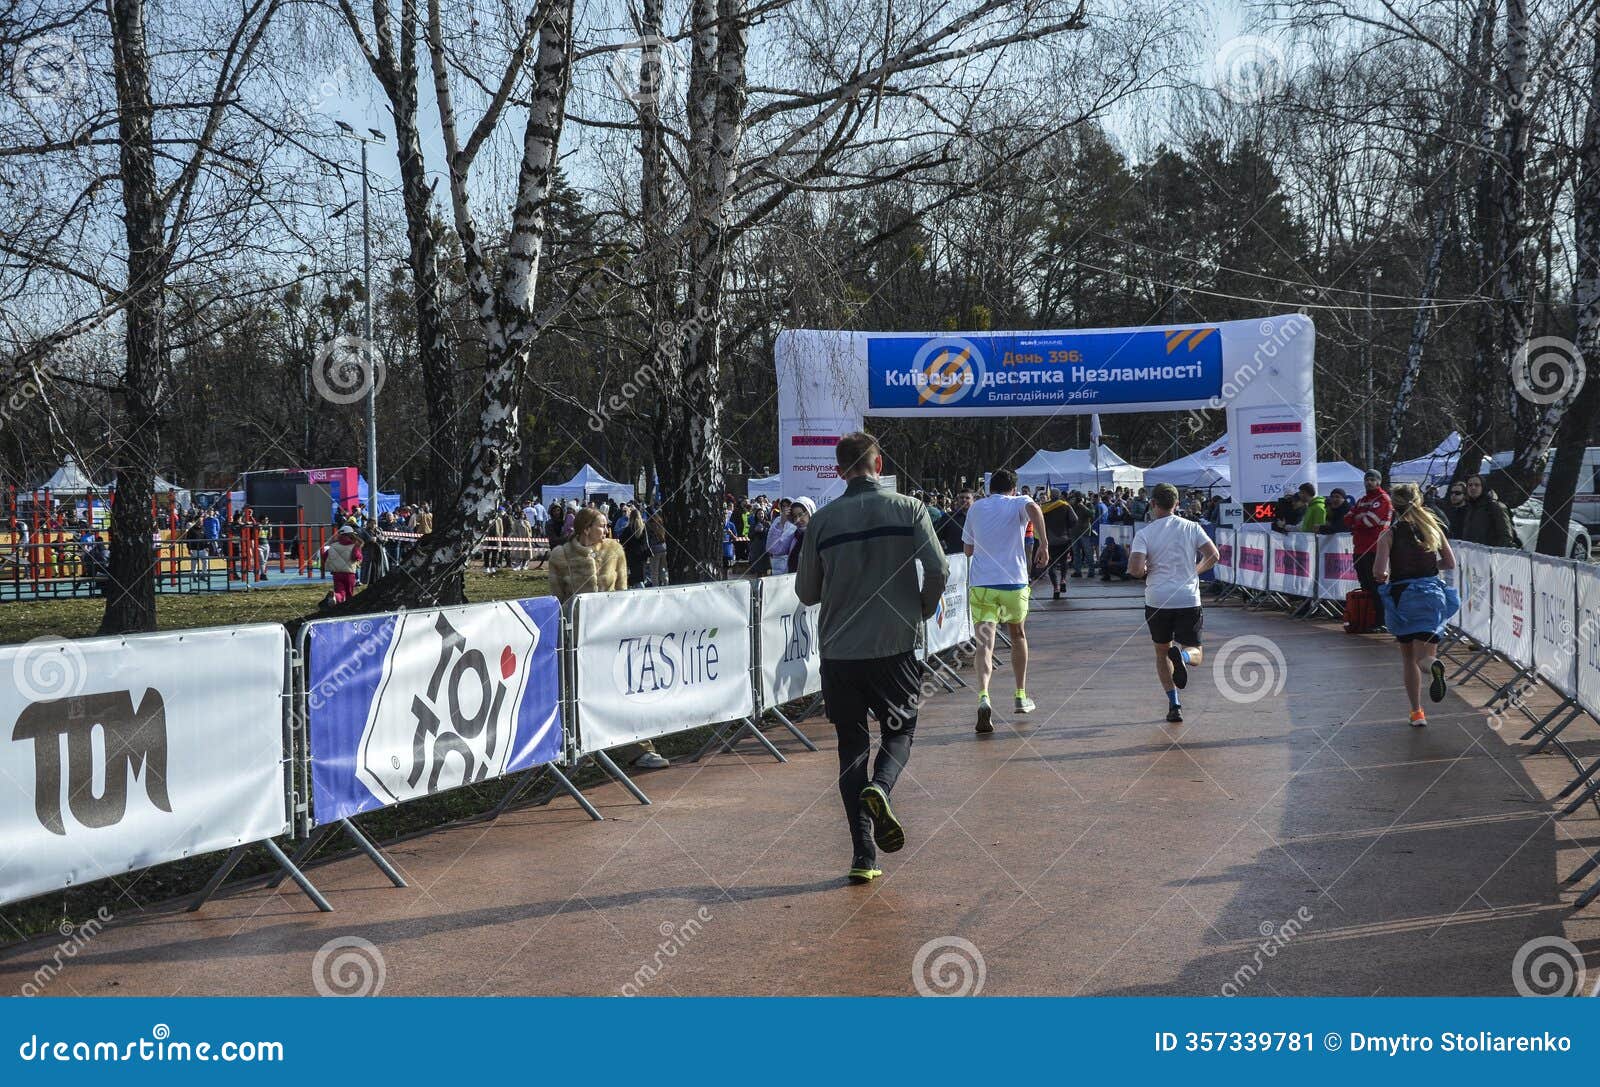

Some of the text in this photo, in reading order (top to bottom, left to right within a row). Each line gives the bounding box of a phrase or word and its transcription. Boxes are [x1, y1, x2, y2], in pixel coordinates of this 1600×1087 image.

[1003, 350, 1083, 367] День 396:
[885, 361, 1202, 388] Київська десятка Незламності
[988, 389, 1099, 402] Благодійний забіг
[1253, 450, 1302, 460] morshynska
[12, 687, 173, 835] TOM
